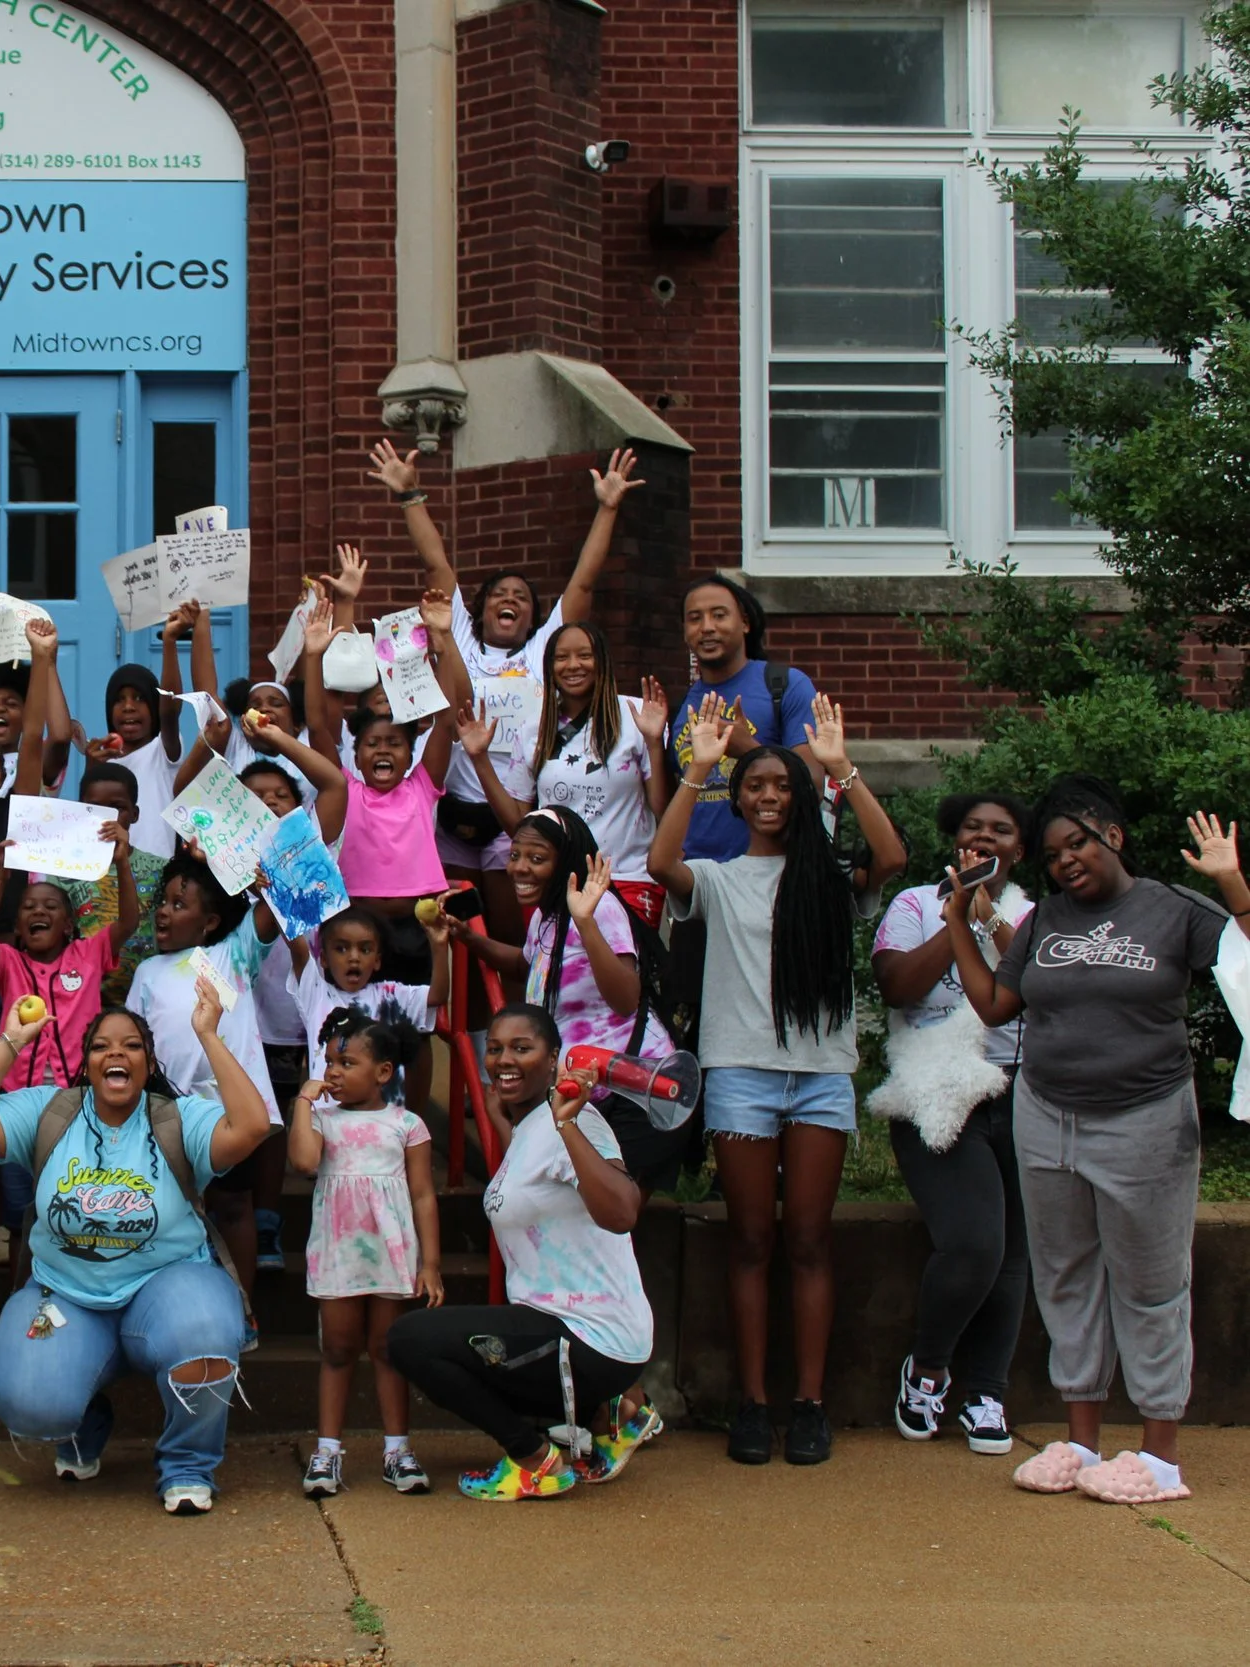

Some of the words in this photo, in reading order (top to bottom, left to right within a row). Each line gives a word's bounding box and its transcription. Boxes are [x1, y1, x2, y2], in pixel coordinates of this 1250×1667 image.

[29, 4, 149, 101] CENTER
[43, 154, 123, 169] 289-6101
[128, 154, 159, 169] Box
[163, 154, 202, 169] 1143
[32, 250, 229, 292] Services
[12, 333, 203, 356] Midtowncs.org
[828, 476, 871, 528] M
[76, 1186, 154, 1217] Camp
[113, 1217, 155, 1233] 2024
